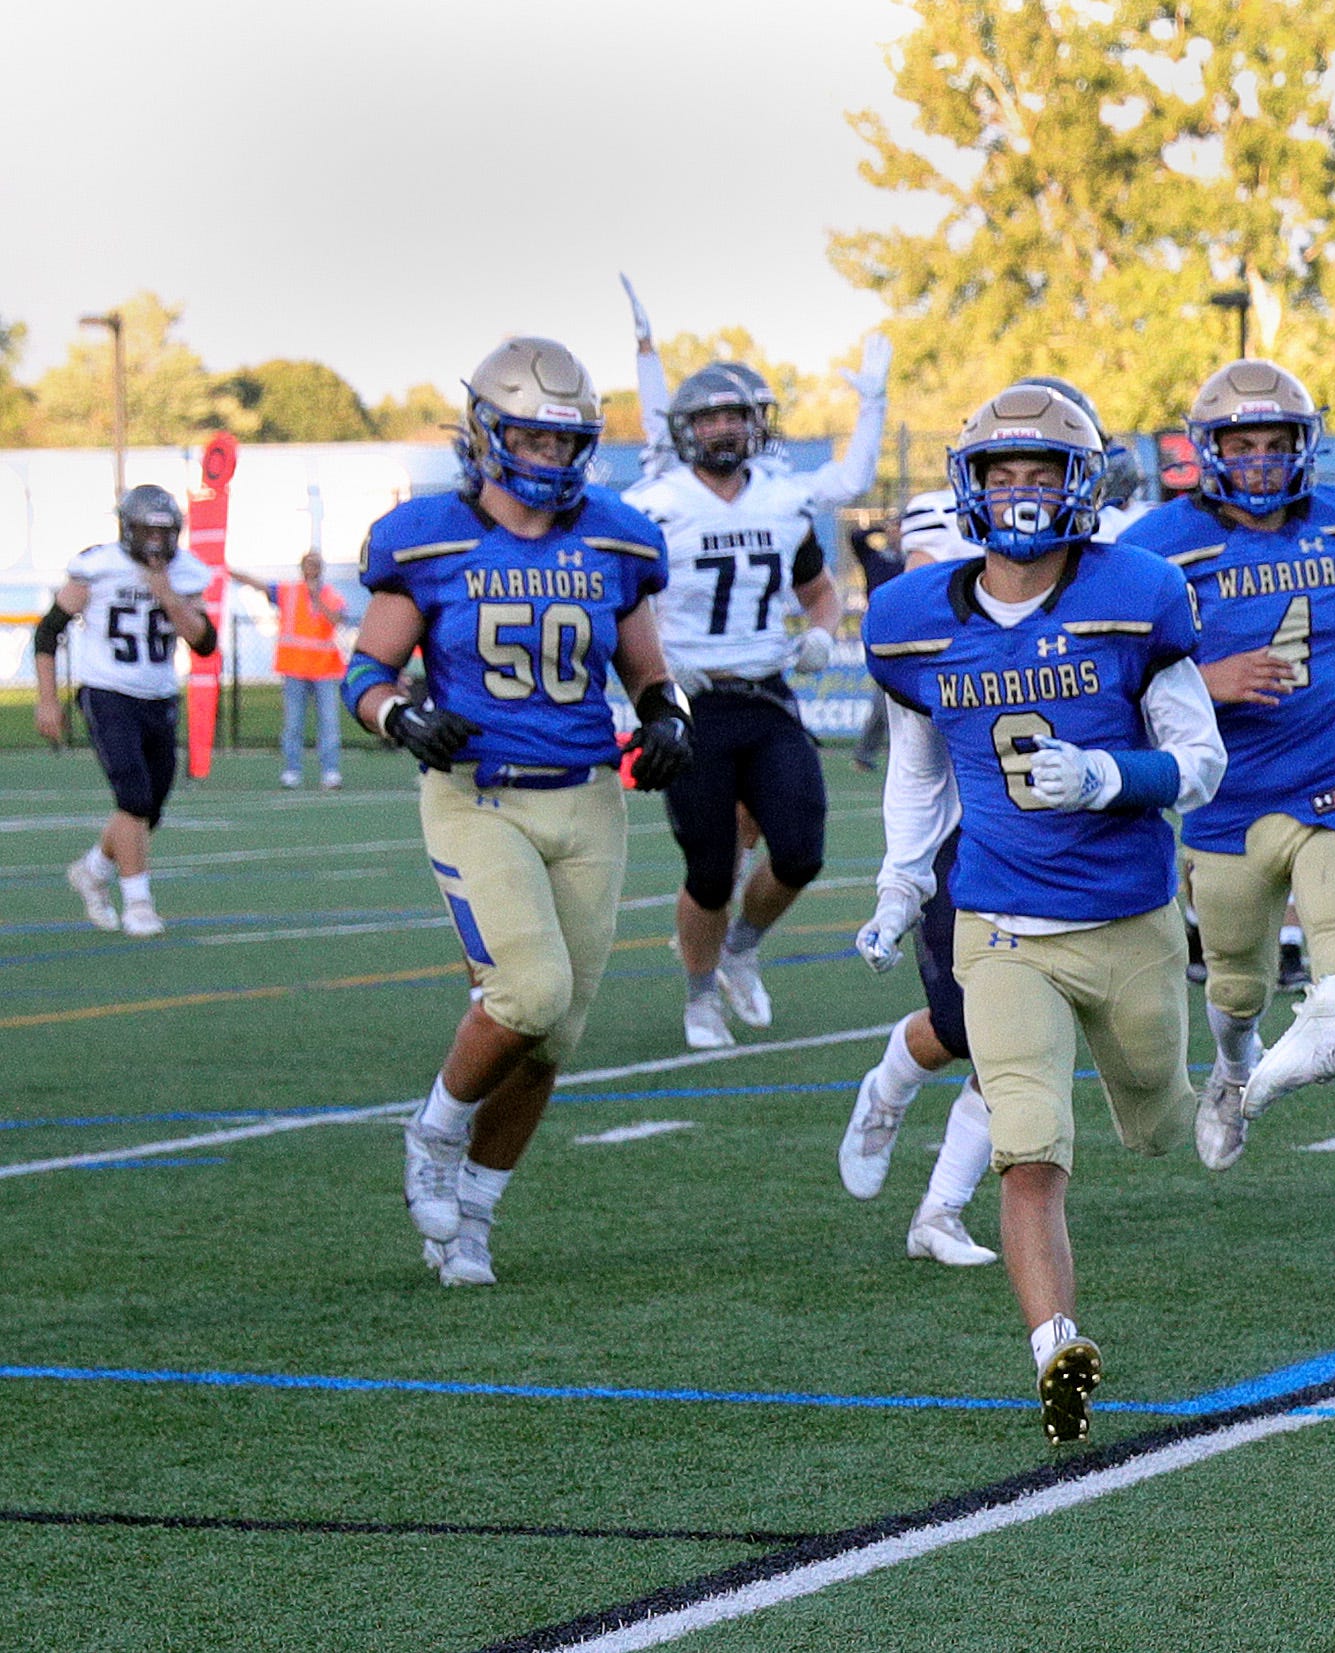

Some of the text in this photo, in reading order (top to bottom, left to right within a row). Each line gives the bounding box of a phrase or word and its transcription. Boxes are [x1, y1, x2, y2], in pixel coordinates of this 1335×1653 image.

[464, 567, 604, 600] WARRIORS
[695, 552, 782, 635] 77
[107, 606, 177, 663] 56
[477, 602, 592, 704] 50
[1268, 595, 1312, 687] 4
[936, 659, 1102, 708] WARRIORS
